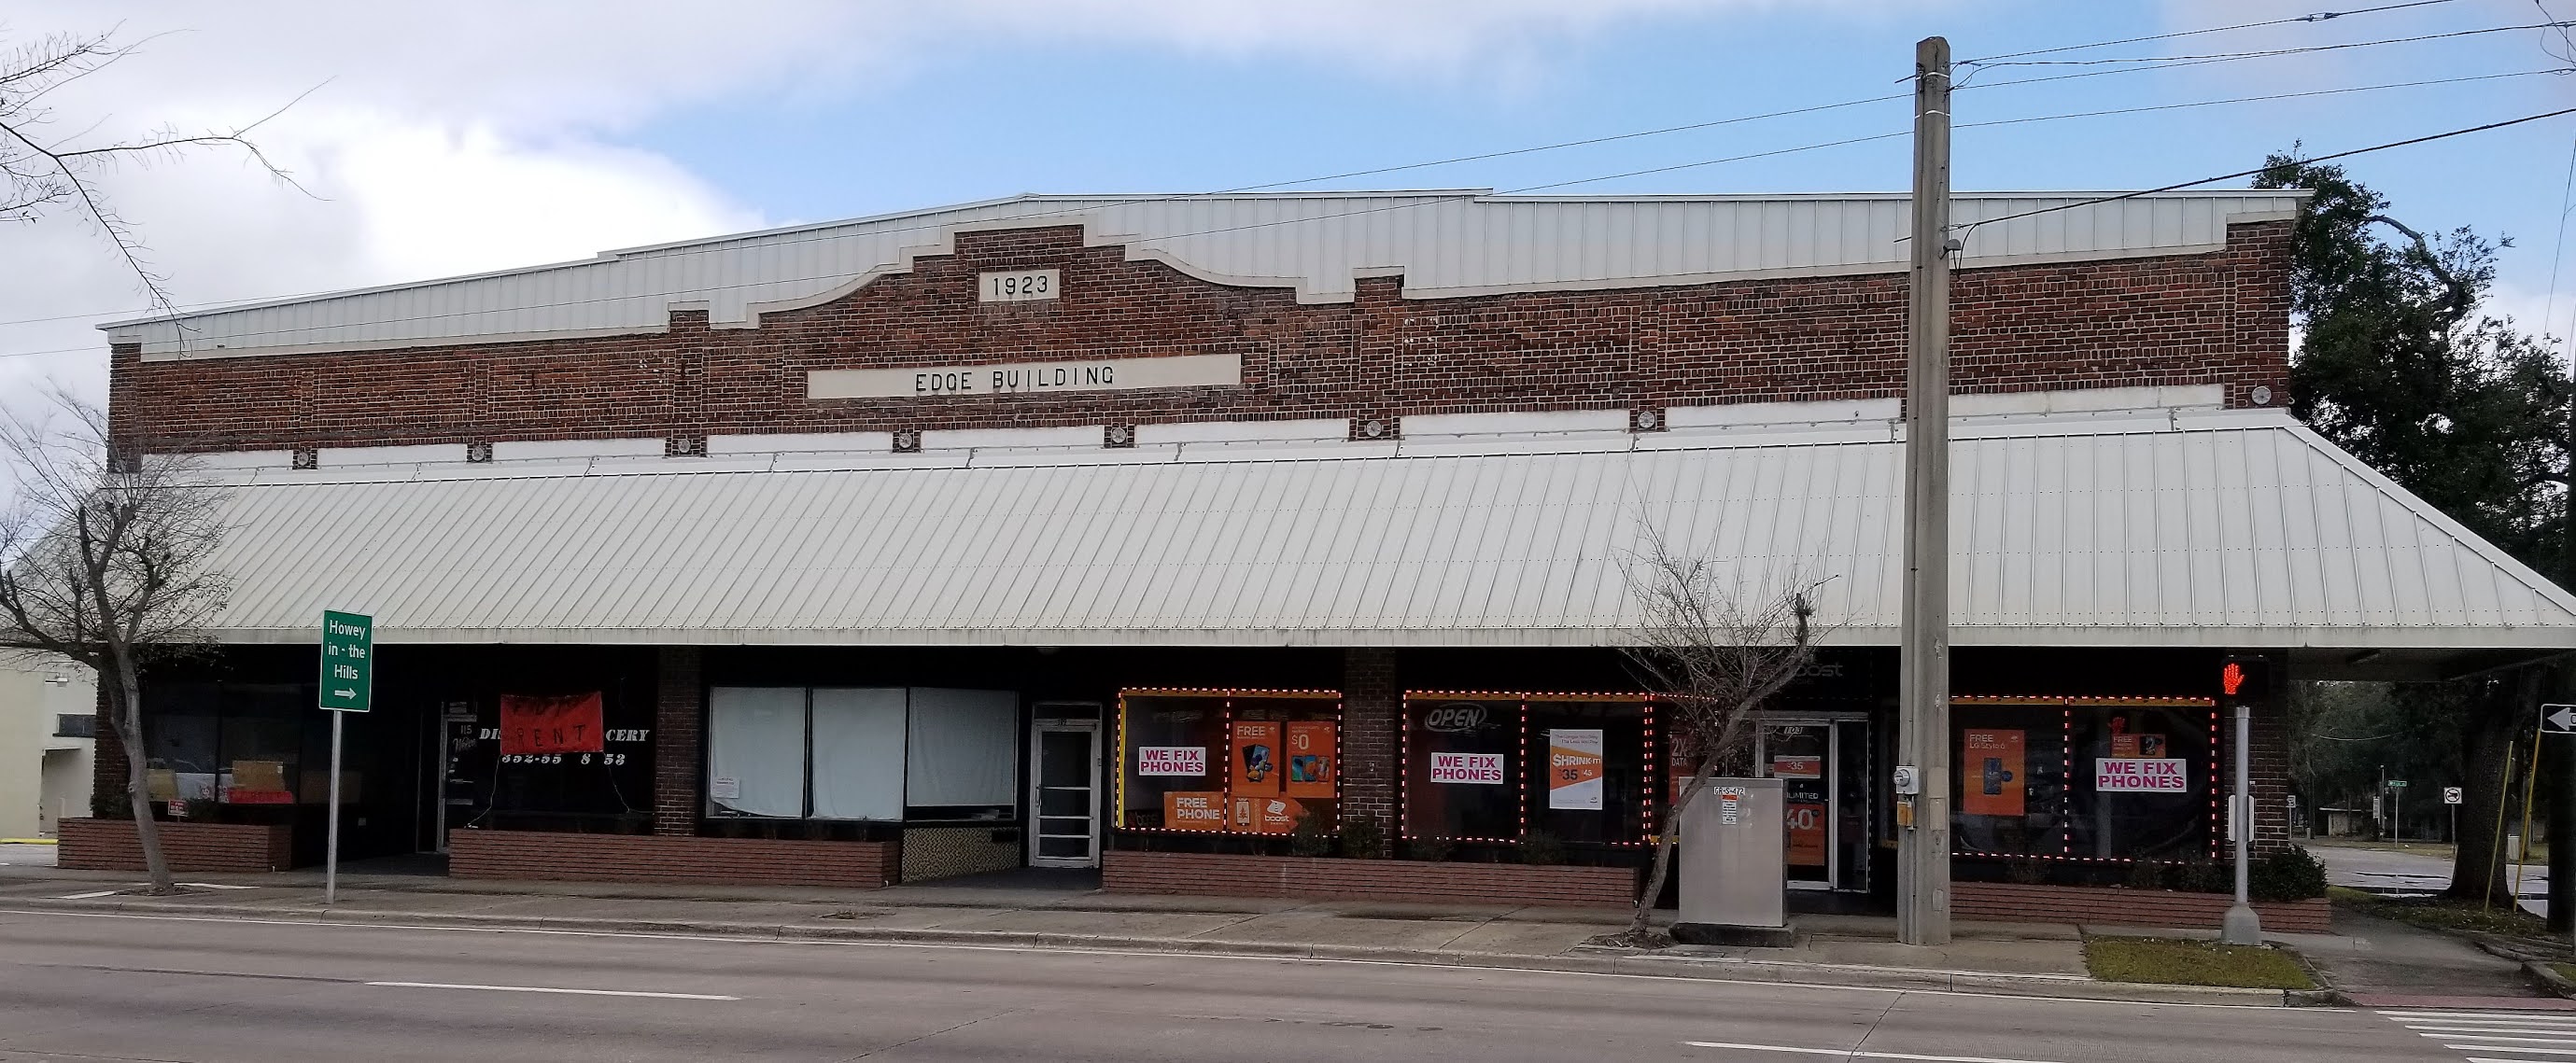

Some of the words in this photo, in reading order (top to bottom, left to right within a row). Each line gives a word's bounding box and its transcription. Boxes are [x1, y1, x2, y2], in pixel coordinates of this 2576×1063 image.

[992, 275, 1049, 296] 1923
[915, 371, 973, 392] EDGE
[992, 366, 1115, 389] BUILDING
[329, 619, 366, 640] Howey
[348, 644, 366, 659] the
[334, 664, 359, 680] Hills
[1429, 707, 1481, 728] OPEN
[460, 724, 472, 734] 115
[604, 729, 650, 742] CERY
[1236, 725, 1266, 736] FREE
[515, 724, 586, 748] RENT
[1291, 734, 1309, 750] $0
[1969, 734, 1994, 742] FREE
[1145, 749, 1169, 762] WE
[1174, 749, 1199, 762] FIX
[1438, 756, 1463, 768] WE
[1470, 757, 1496, 768] FIX
[1140, 762, 1204, 774] PHONES
[1432, 768, 1501, 780] PHONES
[2104, 762, 2136, 775] WE
[2143, 762, 2176, 775] FIX
[2098, 775, 2184, 789] PHONES
[1715, 787, 1744, 795] GR-S-472
[1787, 791, 1819, 800] LIMITED
[1176, 797, 1207, 809] FREE
[1177, 809, 1220, 821] PHONE
[1264, 814, 1290, 823] boost
